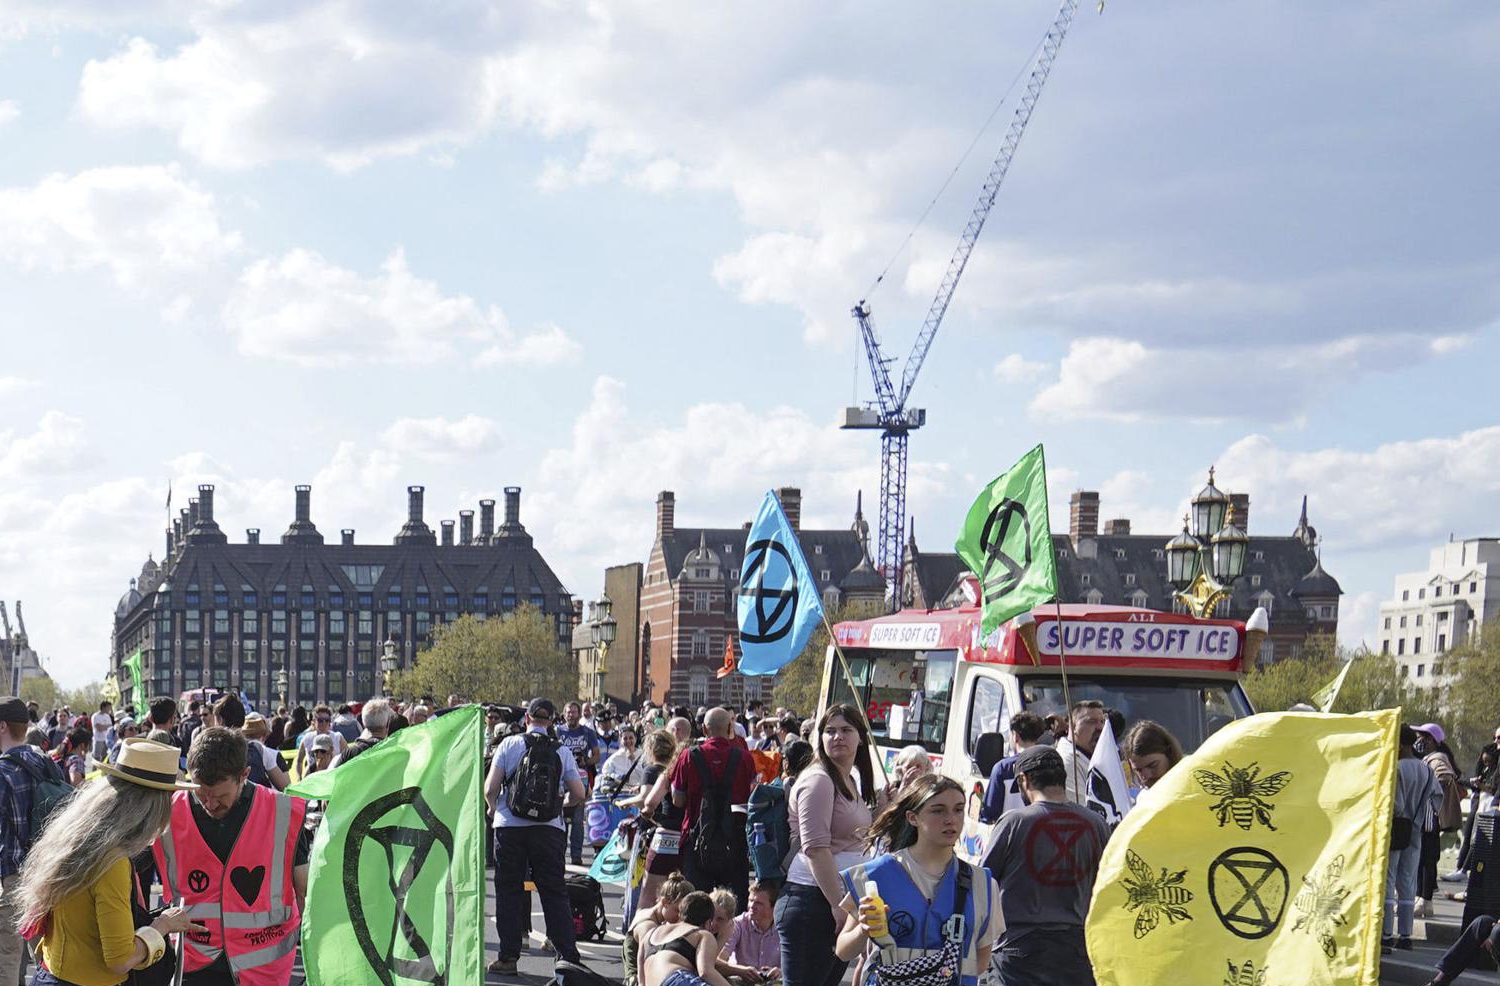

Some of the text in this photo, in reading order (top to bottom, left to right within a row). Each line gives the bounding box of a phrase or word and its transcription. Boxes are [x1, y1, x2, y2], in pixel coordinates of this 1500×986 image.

[1128, 613, 1156, 622] ALI
[872, 627, 898, 642] SUPER
[900, 627, 921, 643] SOFT
[923, 627, 938, 643] ICE
[1047, 625, 1231, 653] SUPER SOFT ICE
